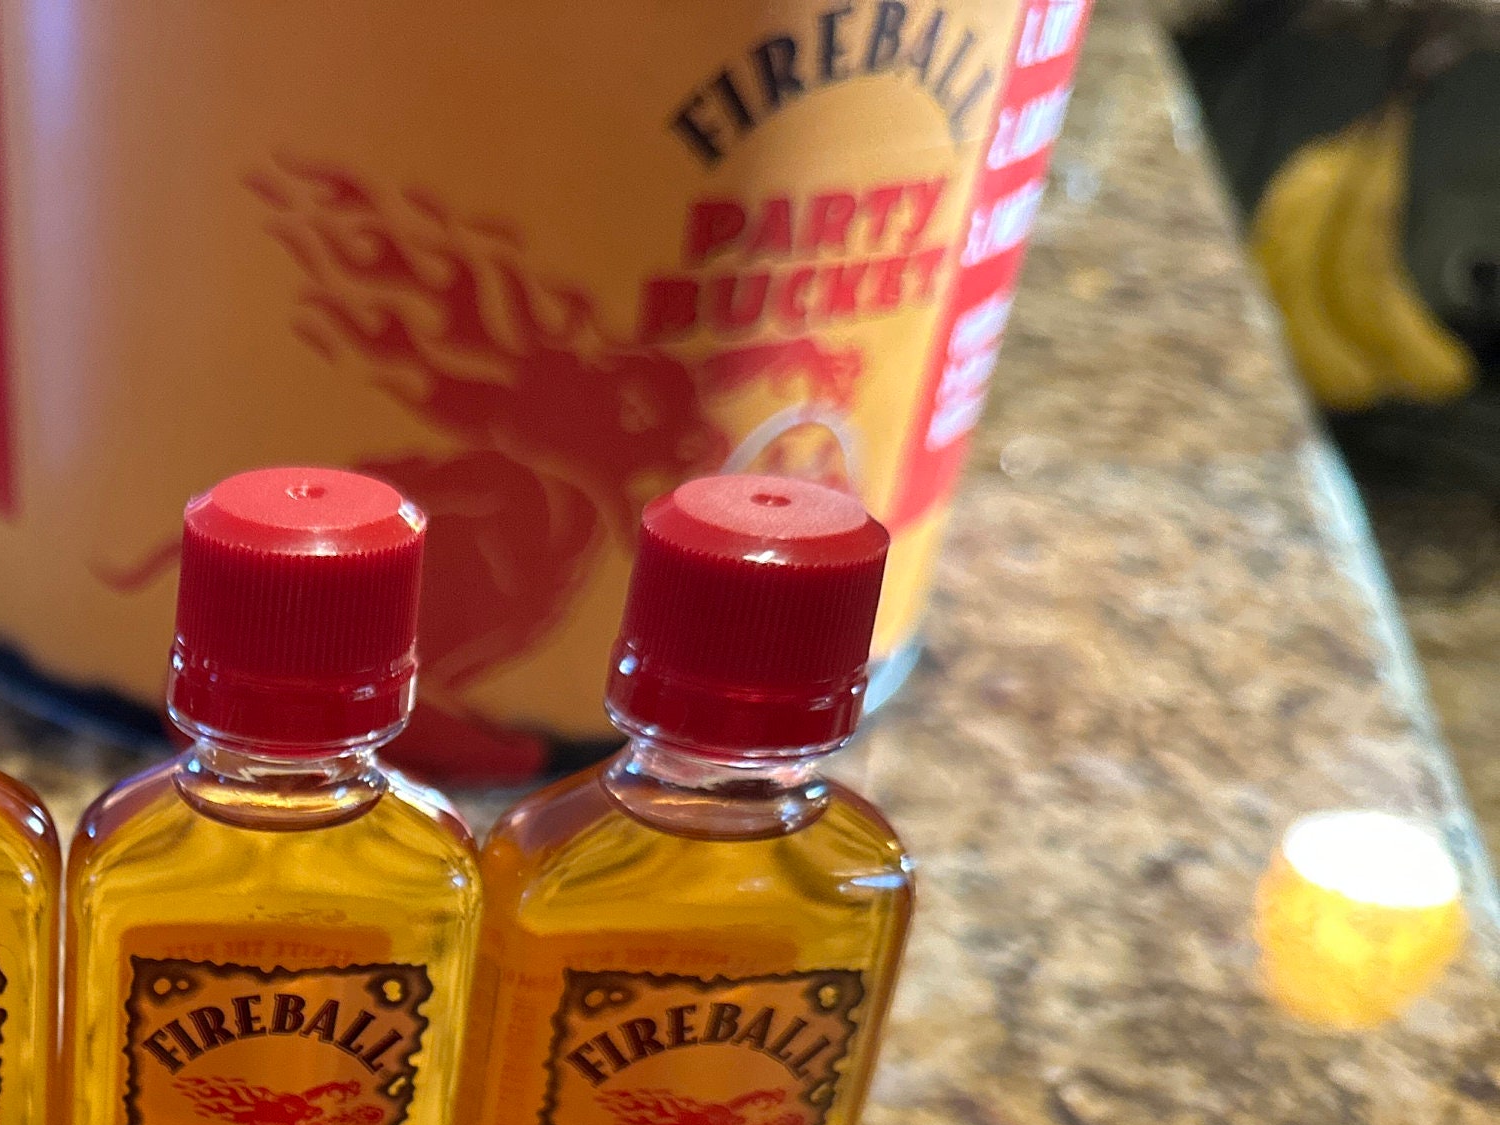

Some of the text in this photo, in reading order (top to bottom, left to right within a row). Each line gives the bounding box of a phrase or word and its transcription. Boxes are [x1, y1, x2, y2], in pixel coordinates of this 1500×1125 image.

[666, 0, 994, 166] FIREBALL
[684, 176, 950, 266] PARTY
[633, 248, 948, 342] BUCKET
[141, 992, 405, 1076] FIREBALL
[564, 1002, 831, 1089] FIREBALL
